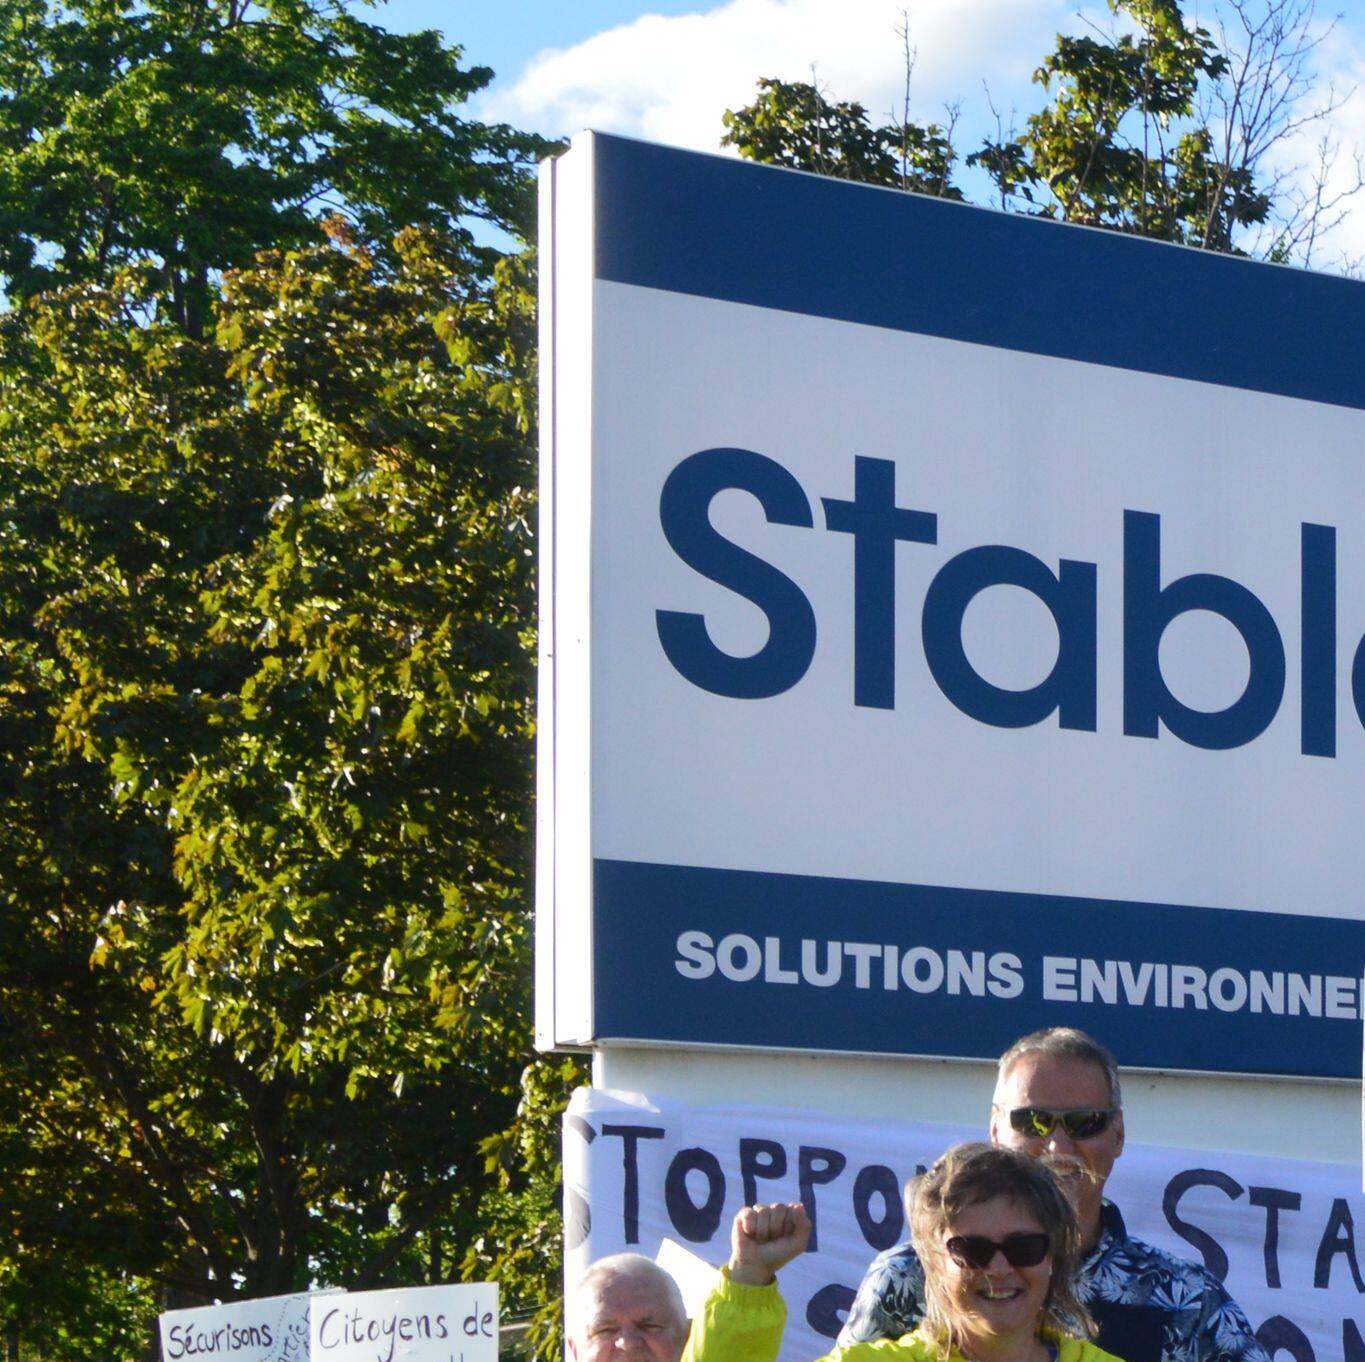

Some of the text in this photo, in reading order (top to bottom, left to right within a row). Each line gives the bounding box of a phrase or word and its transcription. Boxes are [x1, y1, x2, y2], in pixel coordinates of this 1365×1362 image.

[674, 930, 1364, 1020] SOLUTIONS ENVIRONNE
[462, 1300, 494, 1339] de
[167, 1323, 274, 1360] Sécurisons
